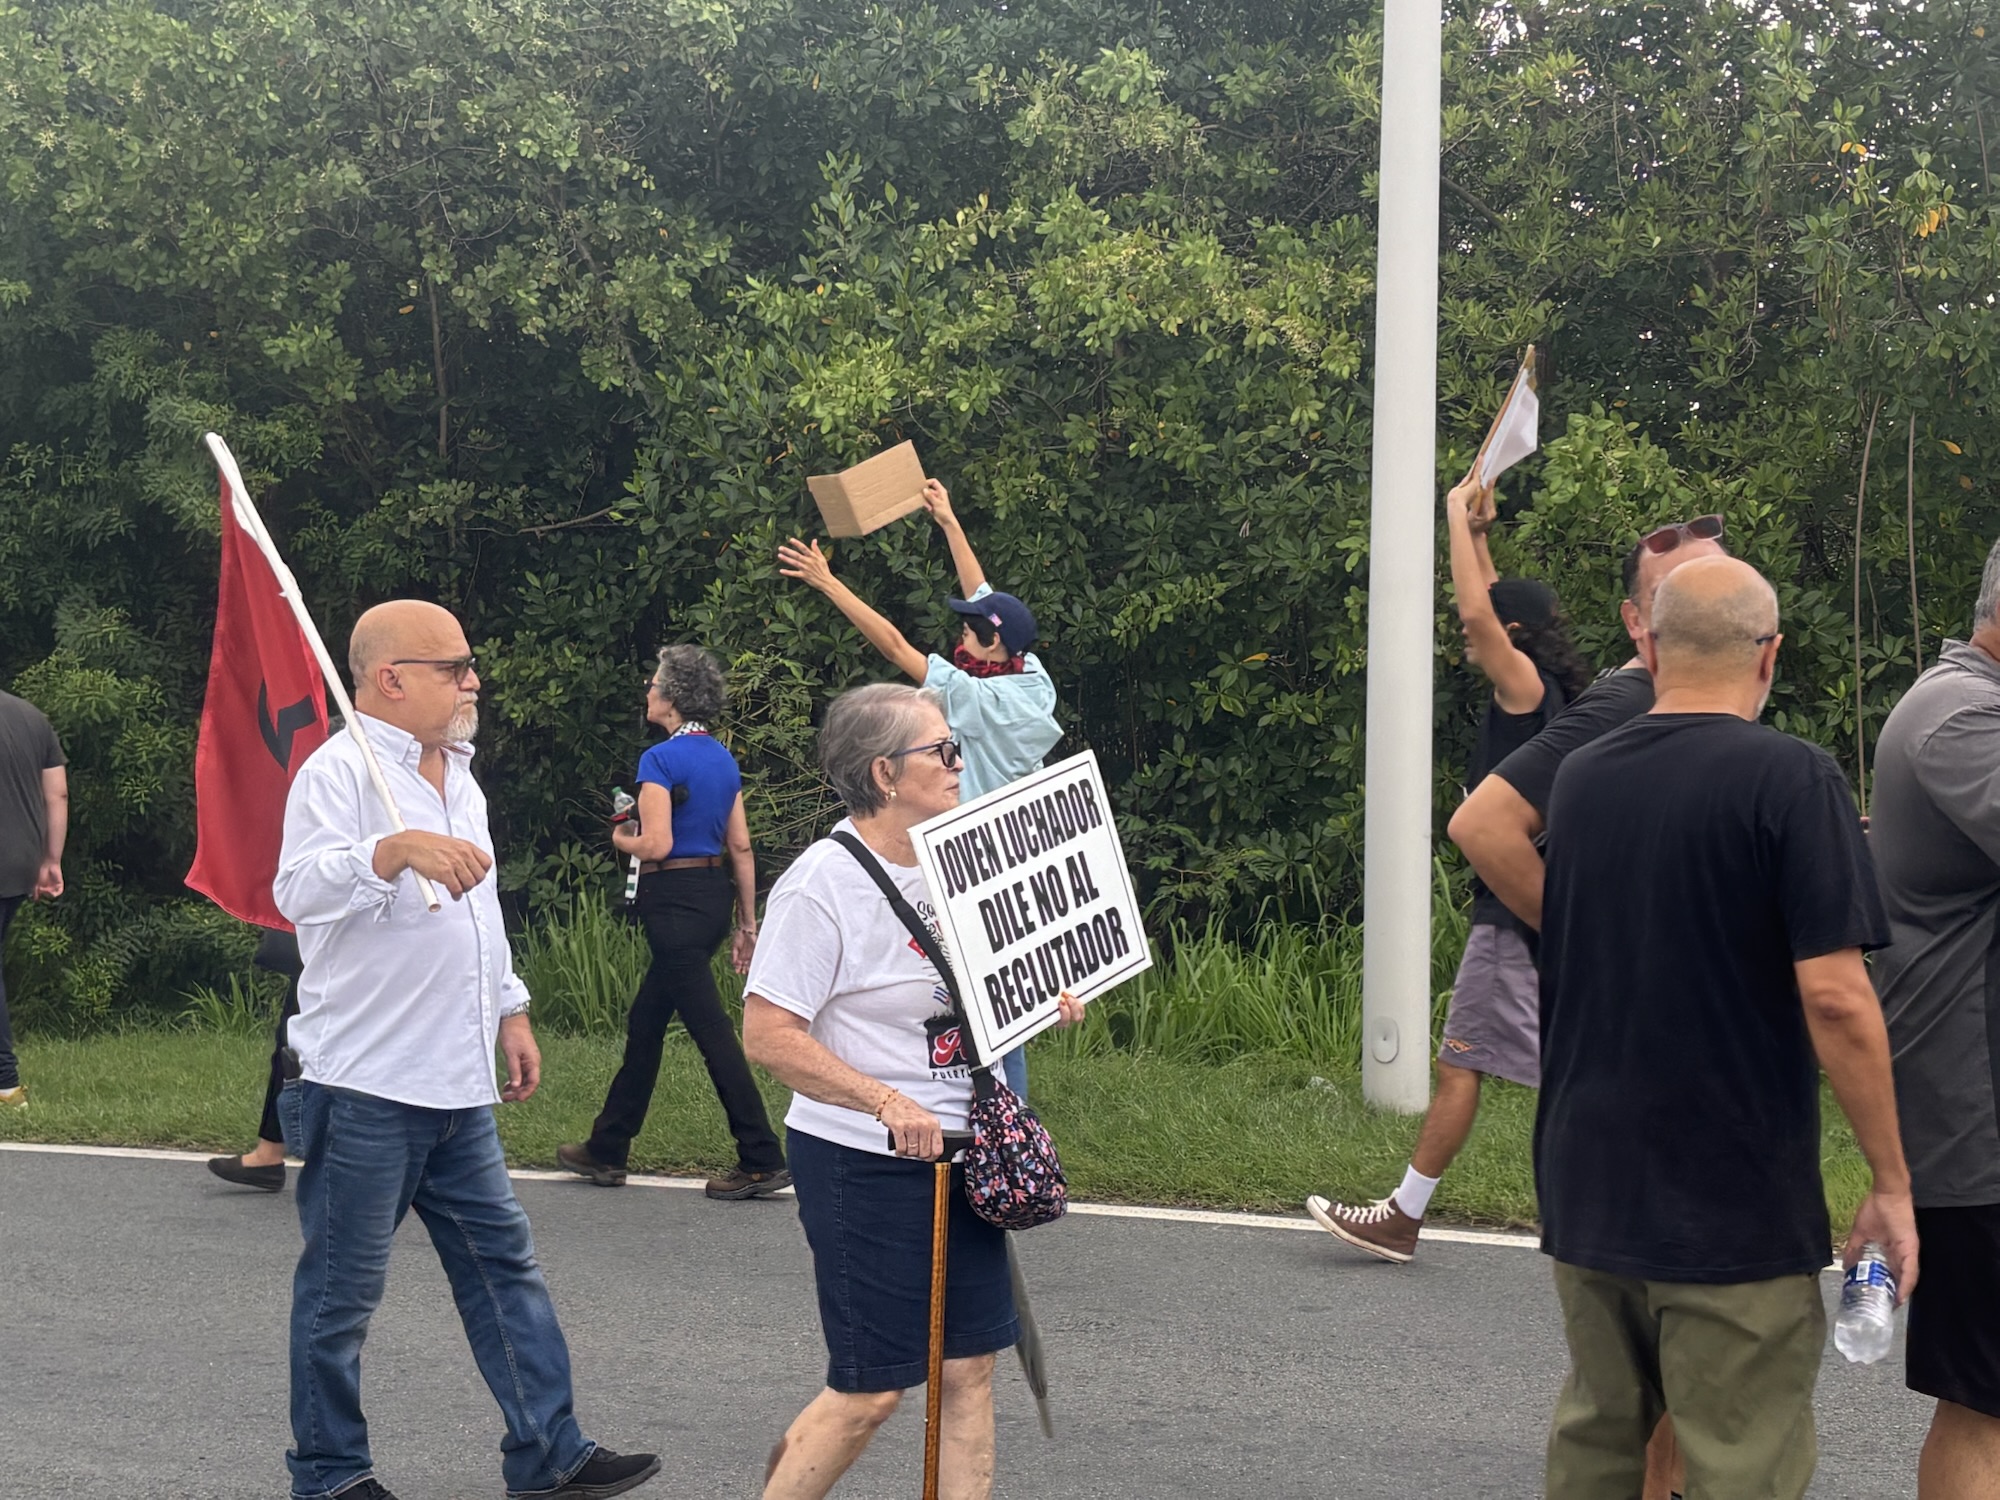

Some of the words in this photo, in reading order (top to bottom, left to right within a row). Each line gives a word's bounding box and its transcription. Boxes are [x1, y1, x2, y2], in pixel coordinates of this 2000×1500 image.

[935, 822, 1004, 899] JOVEN
[994, 778, 1102, 869] LUCHADOR
[978, 881, 1036, 953] DILE
[1029, 864, 1069, 926] NO
[1065, 850, 1100, 908] AL
[984, 907, 1130, 1030] RECLUTADOR
